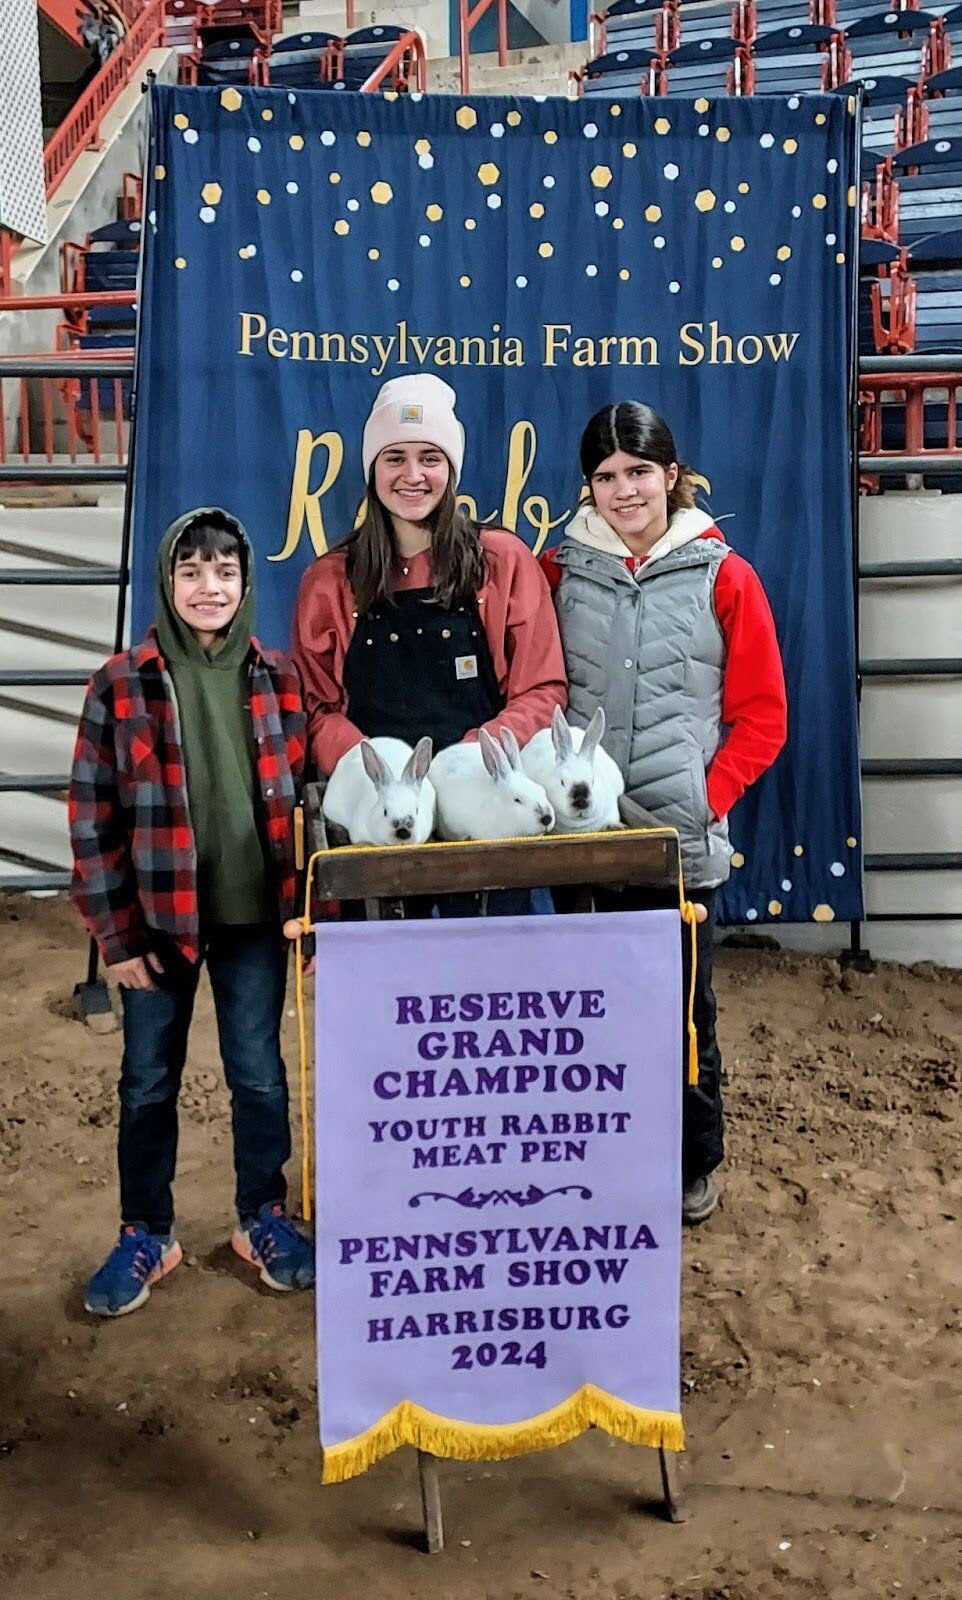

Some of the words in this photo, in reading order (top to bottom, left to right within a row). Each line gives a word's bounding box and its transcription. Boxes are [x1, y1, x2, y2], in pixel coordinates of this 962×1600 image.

[237, 312, 525, 376] Pennsylvania
[542, 324, 660, 367] Farm
[678, 320, 800, 366] Show
[395, 989, 606, 1025] RESERVE
[417, 1026, 585, 1061] GRAND
[373, 1063, 628, 1100] CHAMPION
[367, 1115, 487, 1143] YOUTH
[500, 1111, 632, 1137] RABBIT
[412, 1142, 508, 1170] MEAT
[520, 1139, 588, 1163] PEN
[338, 1224, 660, 1265] PENNSYLVANIA
[369, 1263, 486, 1299] FARM
[507, 1257, 630, 1288] SHOW
[367, 1304, 631, 1343] HARRISBURG
[451, 1340, 548, 1371] 2024
